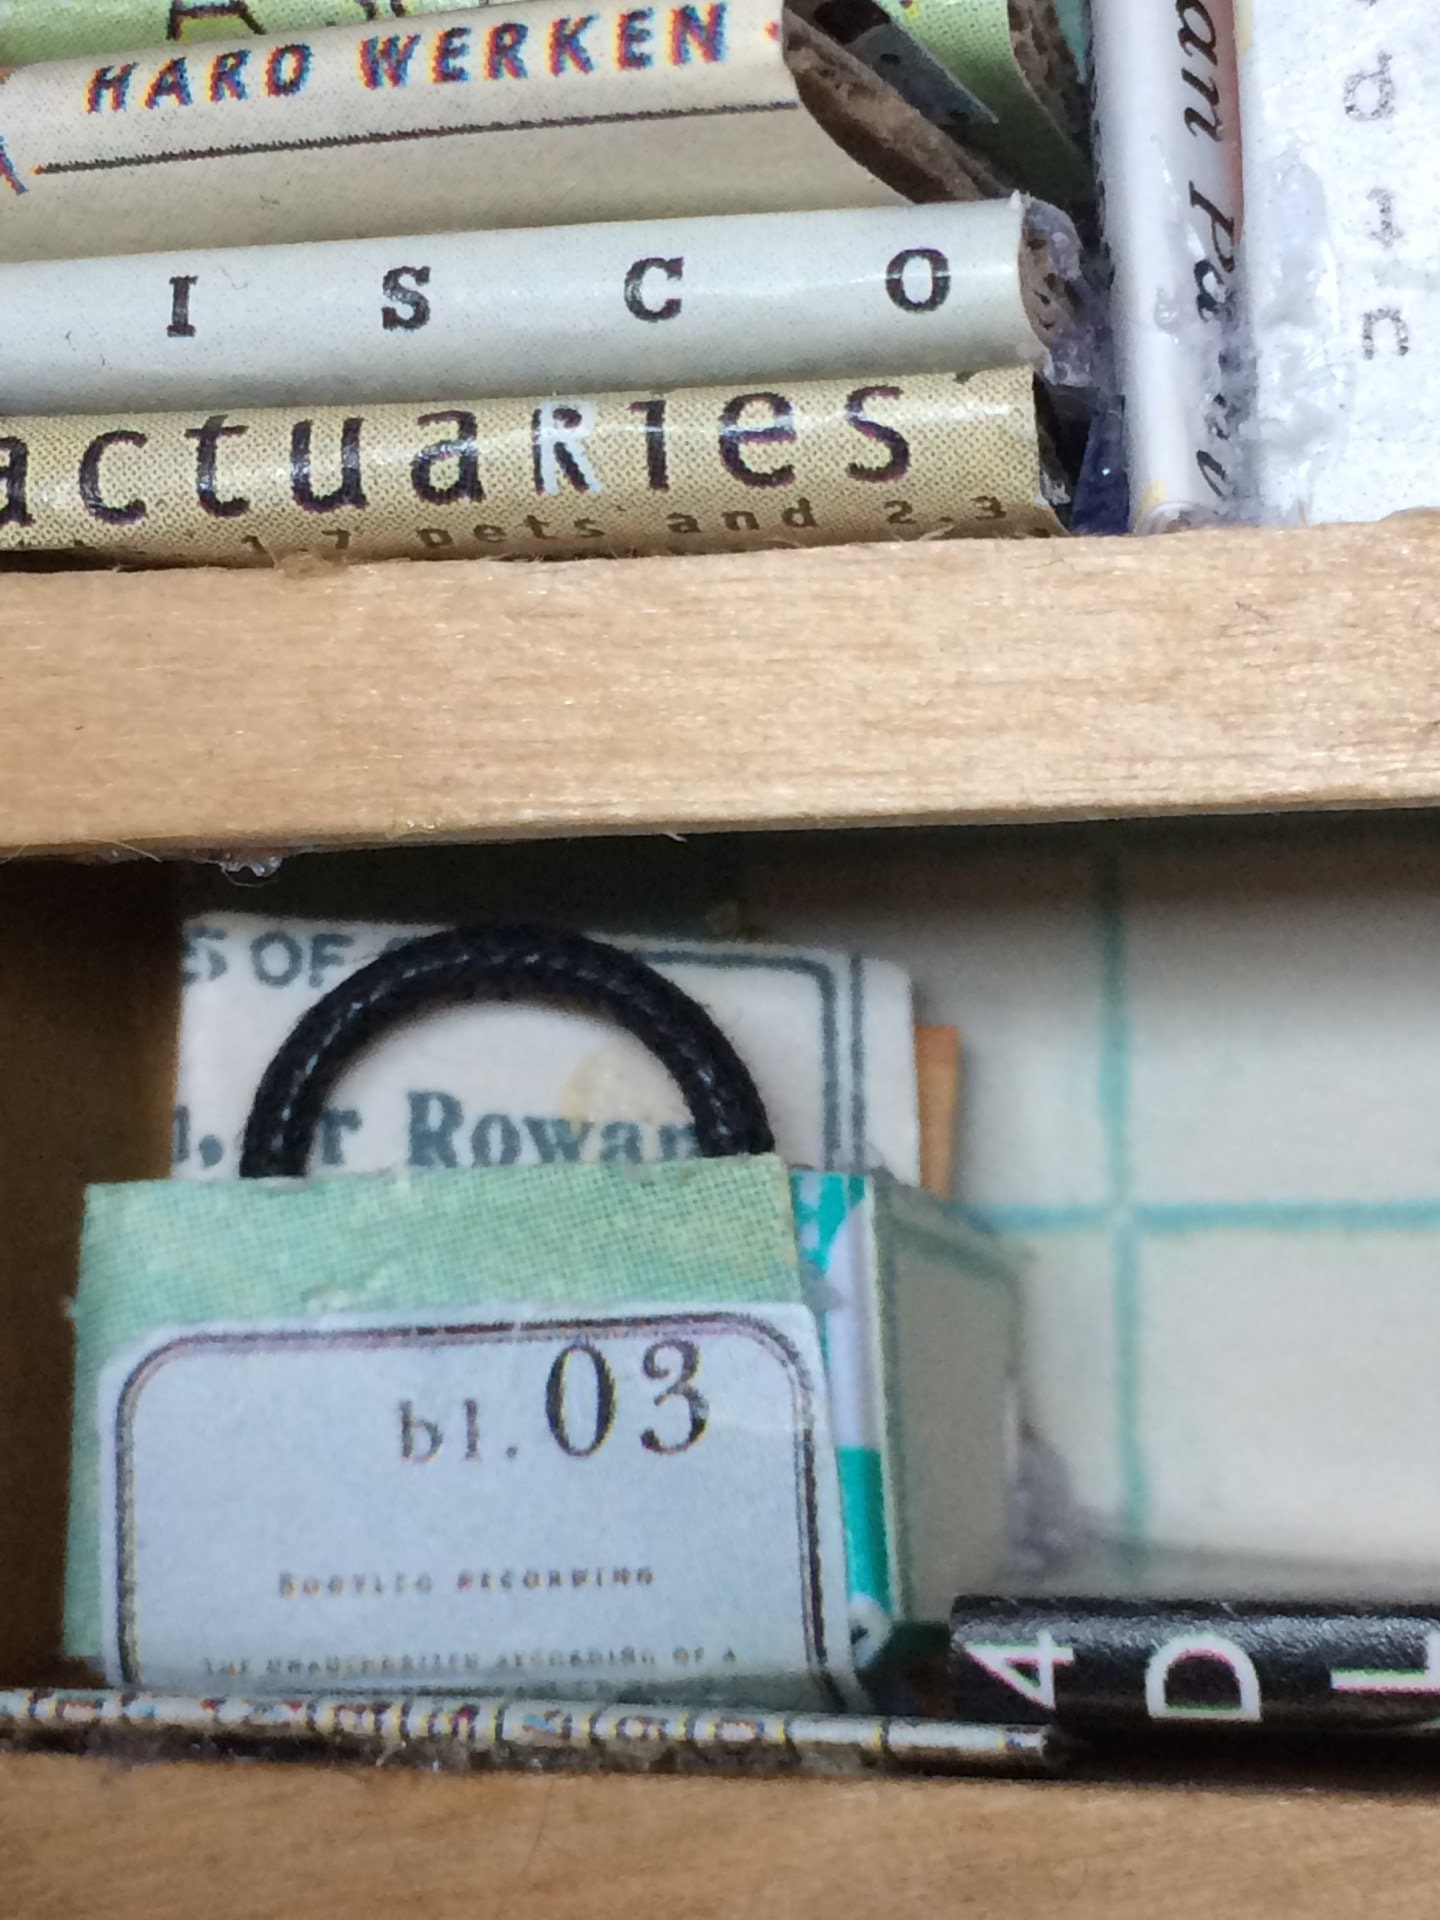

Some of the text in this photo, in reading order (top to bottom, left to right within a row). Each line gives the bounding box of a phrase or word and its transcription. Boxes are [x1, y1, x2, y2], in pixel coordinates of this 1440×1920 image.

[358, 3, 727, 90] WERKEN
[666, 496, 818, 533] and
[251, 930, 354, 989] OF
[406, 1089, 702, 1169] Rowan
